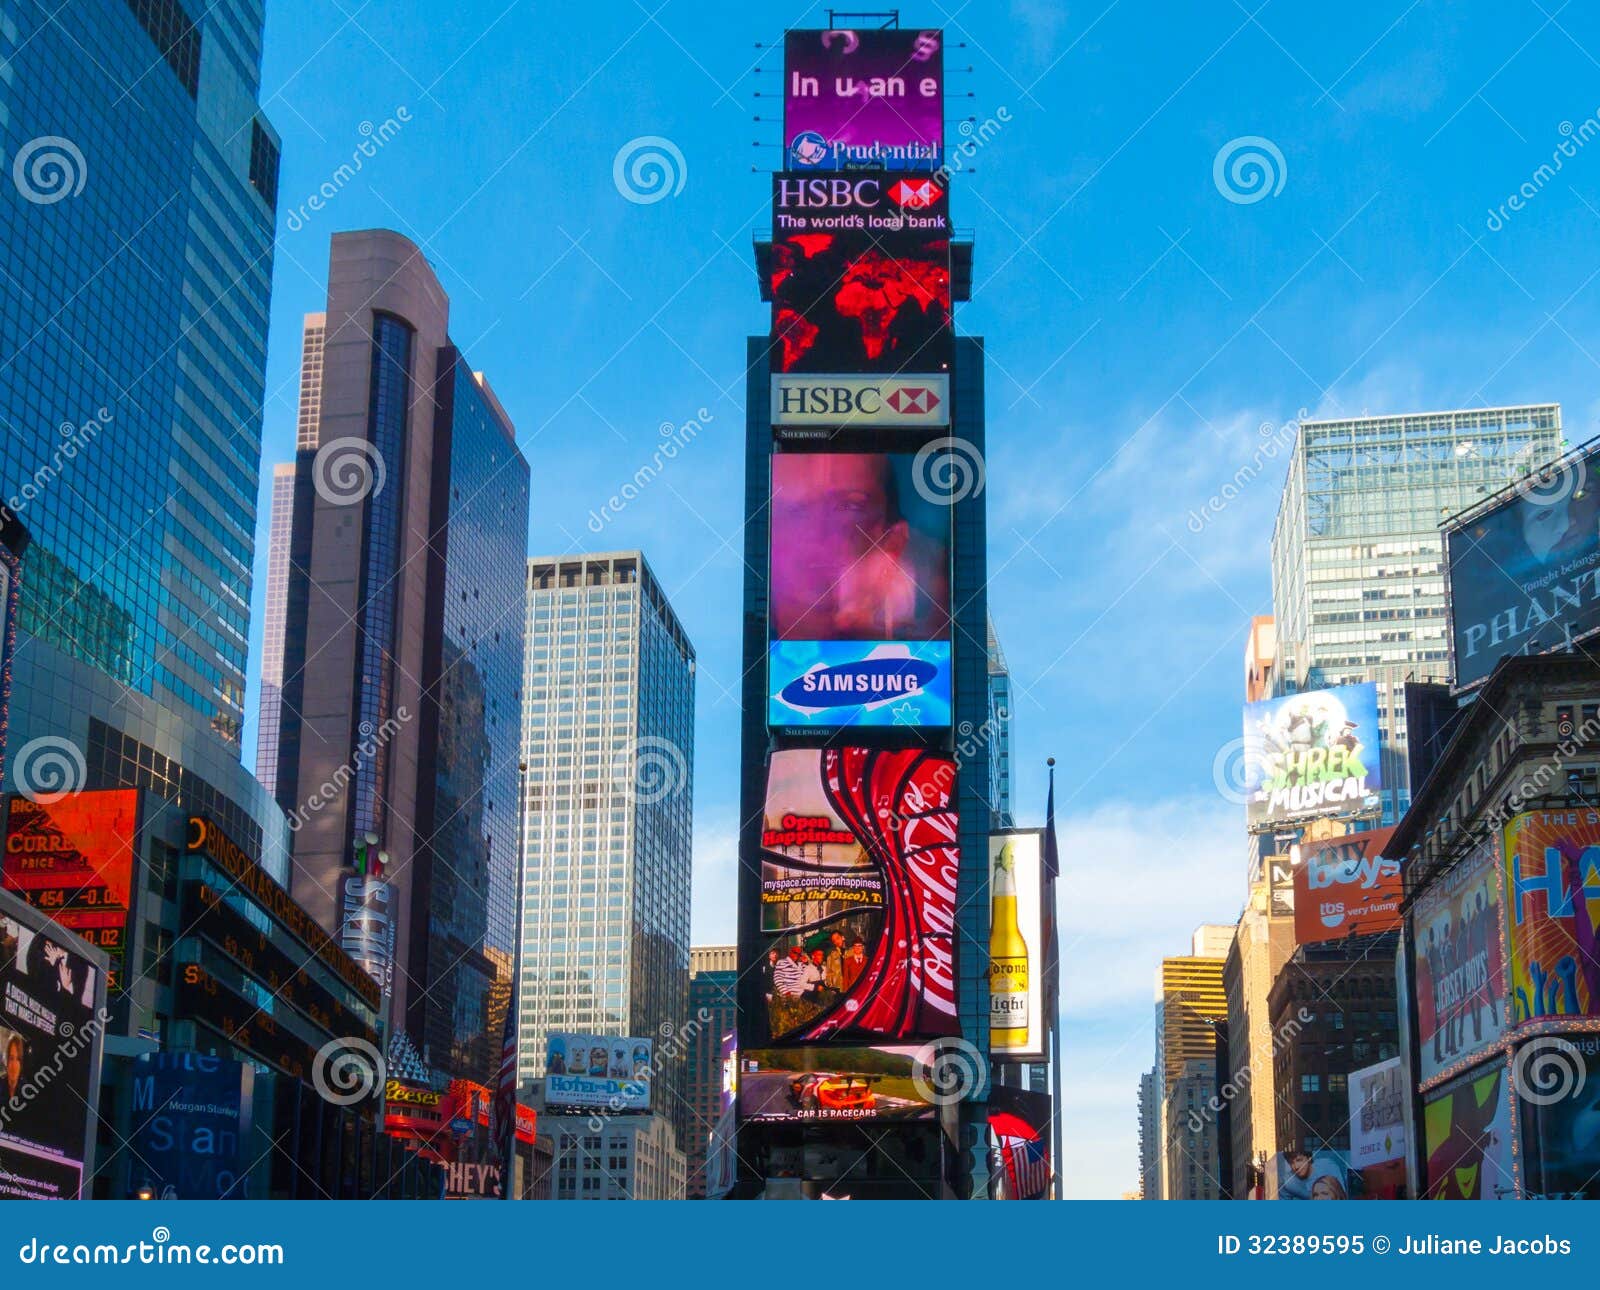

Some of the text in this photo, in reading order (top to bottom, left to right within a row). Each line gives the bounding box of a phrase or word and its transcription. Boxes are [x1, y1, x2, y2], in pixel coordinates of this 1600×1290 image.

[832, 140, 938, 160] Prudential
[777, 179, 880, 208] HSBC
[777, 214, 946, 228] The world's local bank
[779, 387, 881, 415] HSBC
[1521, 570, 1559, 593] Tonight
[803, 674, 918, 692] SAMSUNG
[1266, 776, 1371, 816] MUSICAL
[782, 814, 831, 831] Open
[1541, 812, 1578, 826] THE
[762, 829, 856, 848] Happiness
[21, 857, 55, 868] PRICE
[764, 876, 881, 891] myspace.com/openhappiness
[793, 890, 806, 900] at
[807, 889, 826, 900] the
[1320, 902, 1397, 916] tbs very funny
[386, 1080, 440, 1105] Reese's
[169, 1100, 238, 1119] Morgan Stanley
[797, 1109, 815, 1118] CAR
[818, 1109, 828, 1118] IS
[830, 1109, 877, 1118] RACECARS
